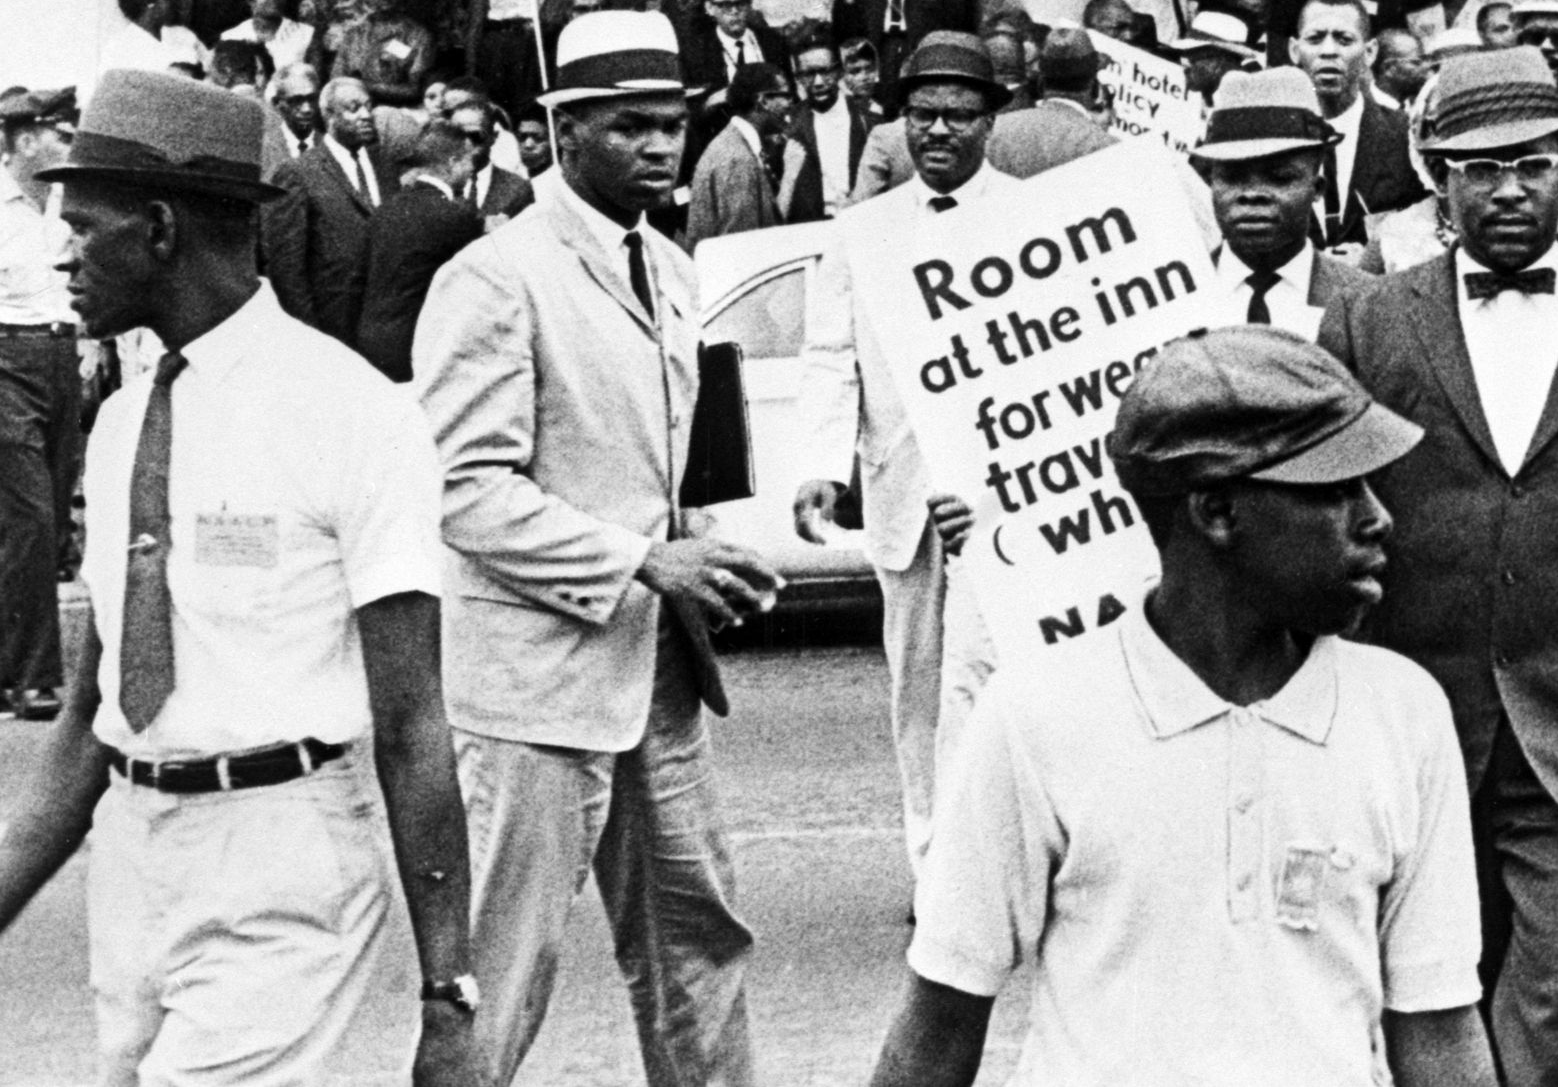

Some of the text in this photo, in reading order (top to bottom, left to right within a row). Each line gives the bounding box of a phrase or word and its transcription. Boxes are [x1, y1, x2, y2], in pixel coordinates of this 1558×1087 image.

[1133, 63, 1188, 101] hotel
[913, 207, 1138, 321] Room
[920, 261, 1197, 393] at the inn
[975, 390, 1053, 450] for
[985, 437, 1103, 513] trav
[1038, 489, 1135, 555] wh
[1038, 592, 1127, 645] NA
